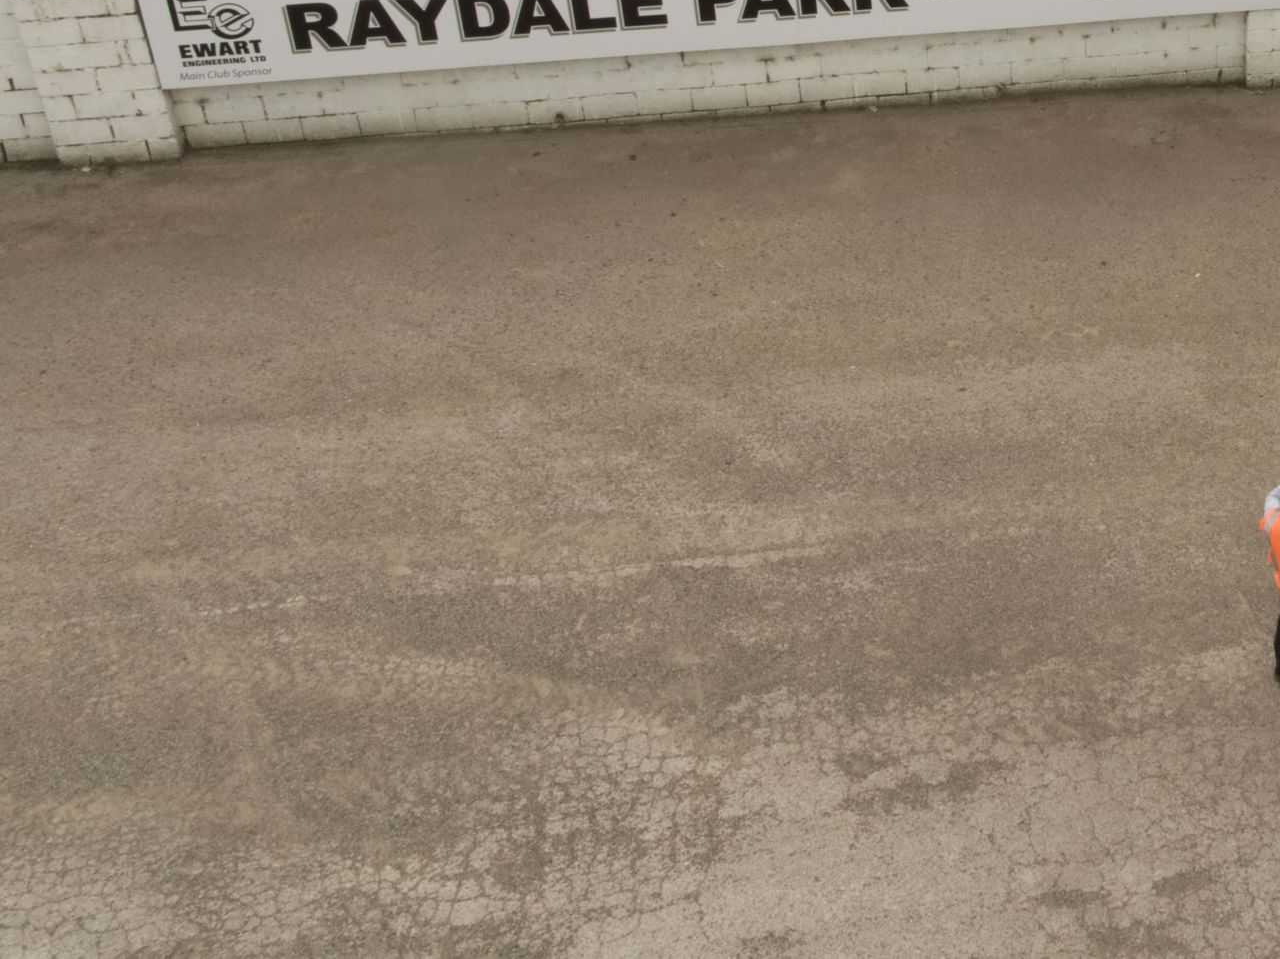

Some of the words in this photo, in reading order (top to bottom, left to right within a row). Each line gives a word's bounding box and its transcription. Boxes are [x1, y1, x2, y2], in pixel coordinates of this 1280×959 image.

[178, 39, 262, 59] EWART
[182, 56, 246, 68] ENGINEERING
[250, 55, 267, 63] LTD
[180, 72, 206, 81] Main
[207, 69, 230, 80] Club
[232, 67, 273, 79] Sponsor
